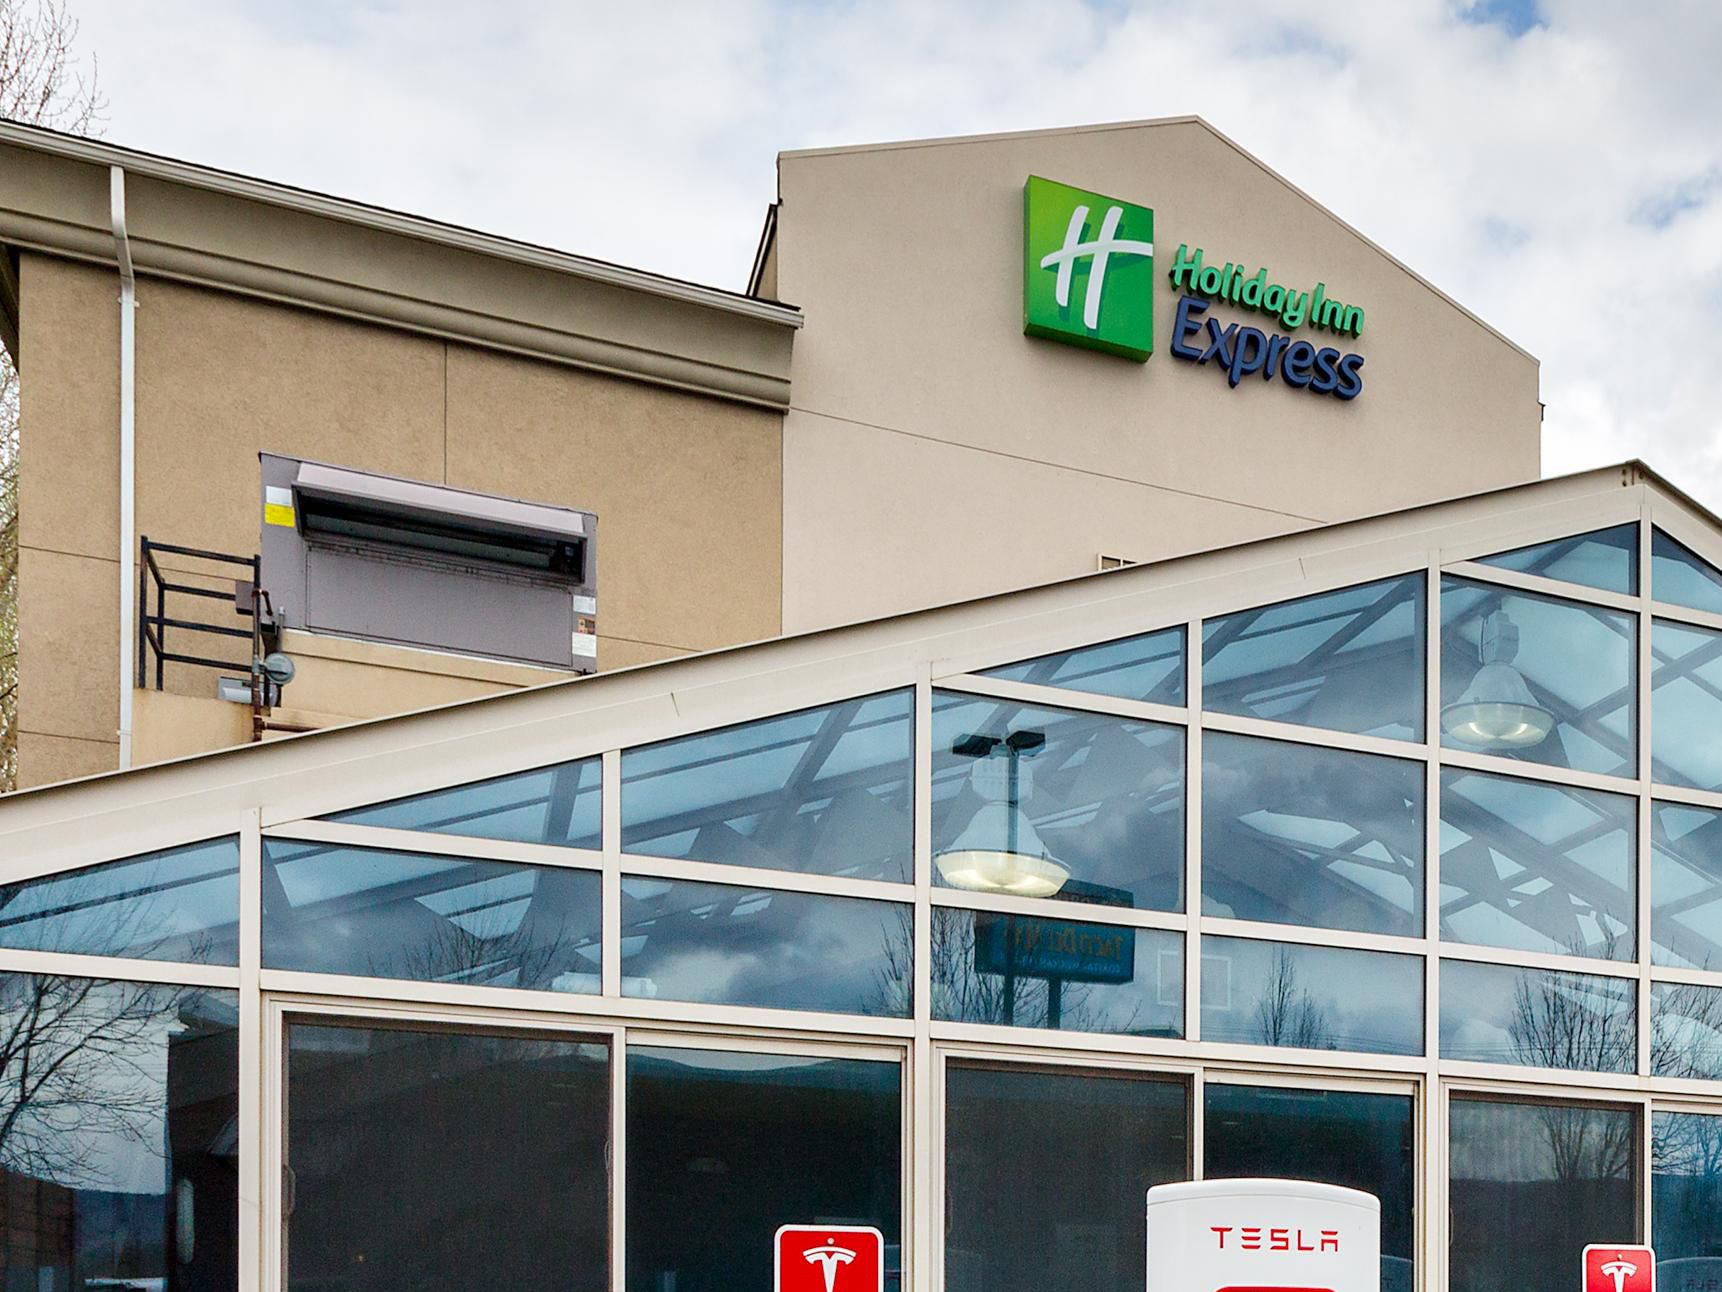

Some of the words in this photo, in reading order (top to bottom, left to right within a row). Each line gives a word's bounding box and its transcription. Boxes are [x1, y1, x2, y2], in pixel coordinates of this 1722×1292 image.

[1168, 243, 1309, 331] Holiday
[1308, 282, 1365, 339] Inn
[1170, 295, 1365, 400] Express
[1210, 1226, 1339, 1252] TESLA
